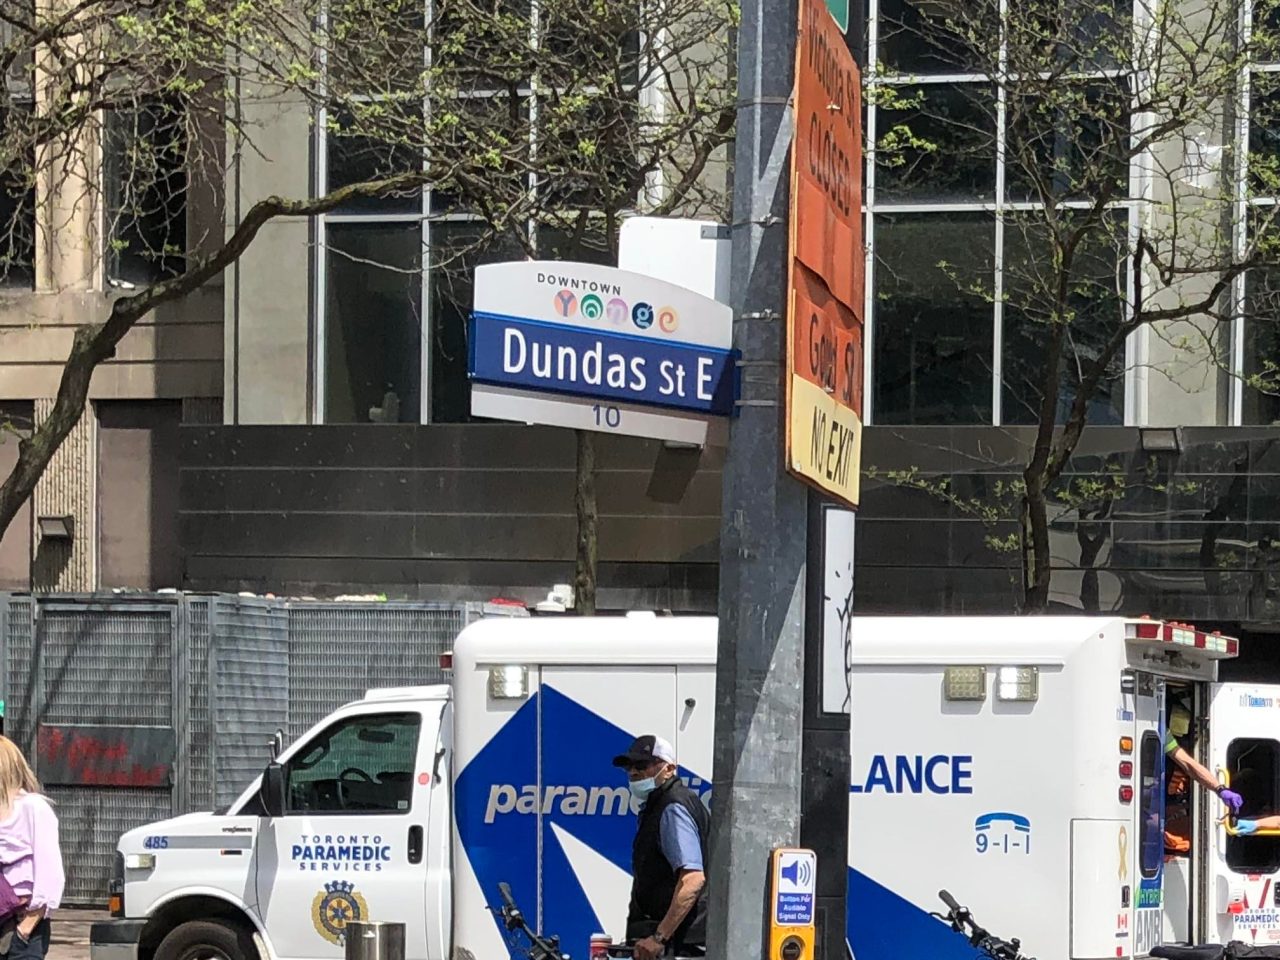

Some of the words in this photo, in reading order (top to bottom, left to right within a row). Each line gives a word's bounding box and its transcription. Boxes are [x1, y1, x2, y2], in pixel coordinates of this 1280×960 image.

[809, 112, 850, 218] CLOSED
[537, 273, 622, 296] DOWNTOWN
[503, 327, 647, 391] Dundas
[658, 359, 686, 397] St
[696, 356, 713, 400] E
[592, 404, 621, 428] 10
[810, 405, 827, 474] NO
[826, 420, 854, 488] EXIT
[144, 836, 169, 850] 485
[301, 835, 383, 845] TORONTO
[291, 845, 391, 862] PARAMEDIC
[299, 862, 383, 872] SERVICES
[1234, 914, 1280, 923] PARAMEDIC
